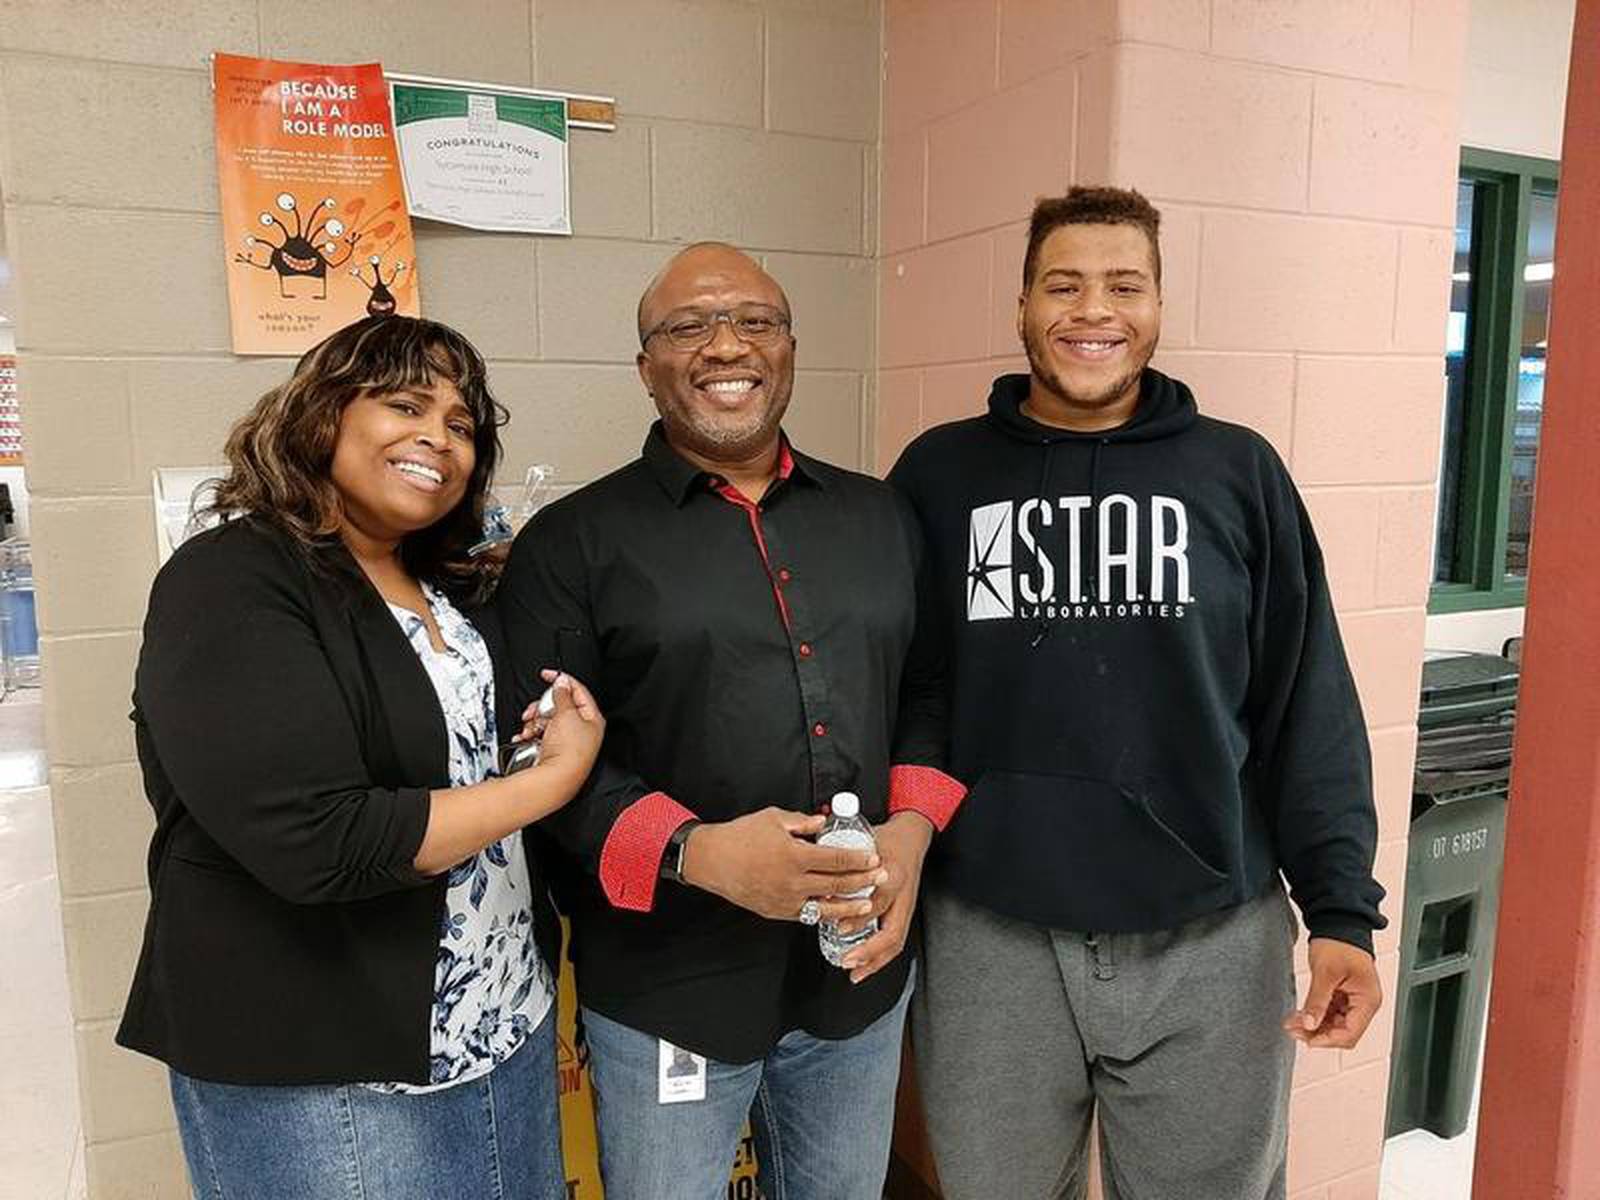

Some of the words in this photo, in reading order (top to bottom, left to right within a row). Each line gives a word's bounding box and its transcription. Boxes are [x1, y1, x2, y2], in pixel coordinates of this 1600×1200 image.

[280, 80, 357, 100] BECAUSE
[281, 101, 287, 114] I
[293, 102, 323, 117] AM
[329, 106, 342, 118] A
[283, 119, 327, 136] ROLE
[333, 123, 386, 138] MODEL
[426, 136, 540, 159] CONGRATULATIONS
[1020, 604, 1185, 618] LABORATORIES
